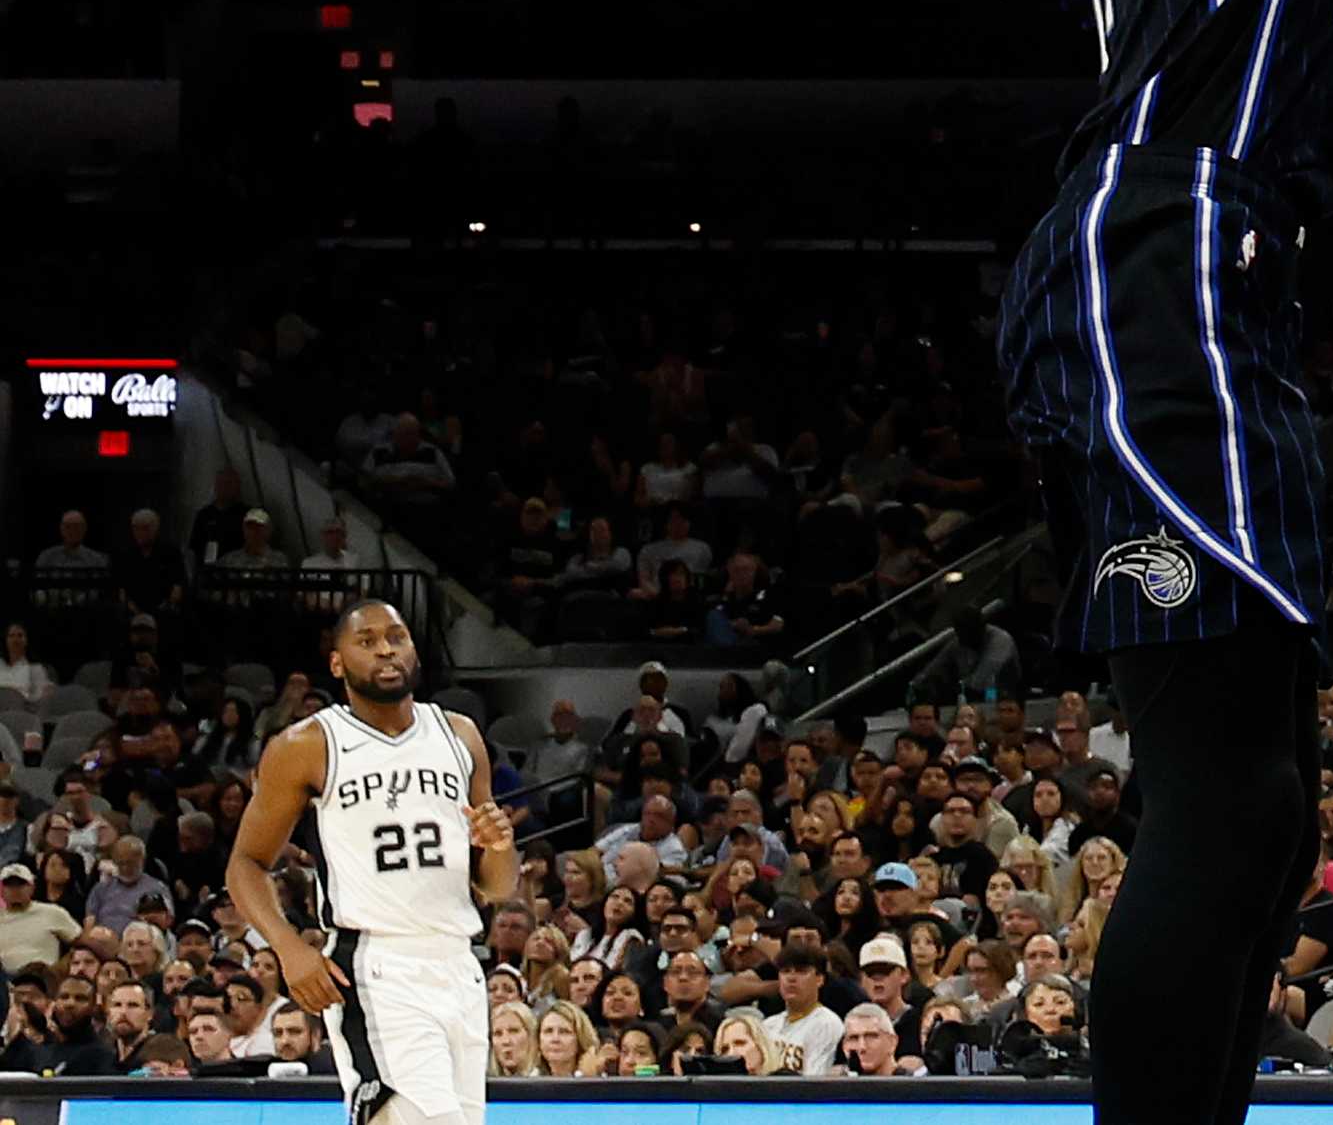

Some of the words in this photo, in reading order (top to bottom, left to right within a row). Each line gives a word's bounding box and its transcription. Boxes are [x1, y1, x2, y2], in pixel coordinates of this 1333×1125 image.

[39, 372, 106, 395] WATCH
[63, 395, 93, 419] ON
[339, 769, 460, 810] SPURS
[374, 822, 445, 872] 22
